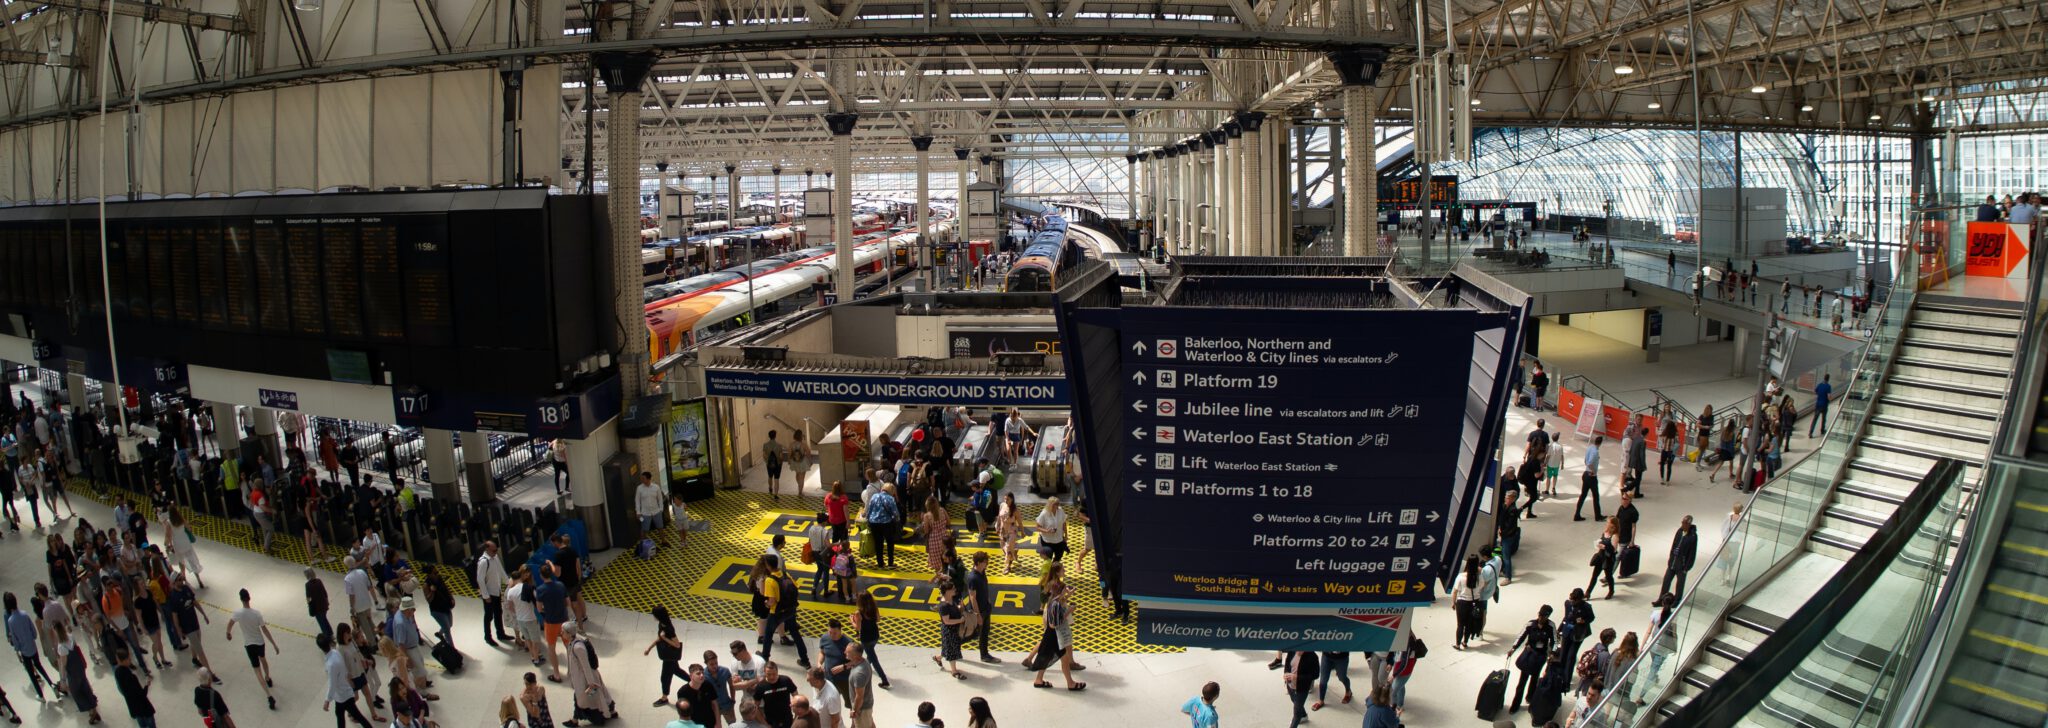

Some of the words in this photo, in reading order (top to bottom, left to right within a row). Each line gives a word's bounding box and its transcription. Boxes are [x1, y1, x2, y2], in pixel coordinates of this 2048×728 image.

[825, 296, 835, 305] 17
[1185, 337, 1243, 350] Bakerloo,
[1247, 338, 1304, 349] Northern
[1308, 339, 1331, 349] and
[1185, 350, 1242, 362] Waterloo
[1246, 352, 1256, 362] &
[1260, 352, 1286, 365] City
[1289, 352, 1318, 363] lines
[1323, 355, 1336, 363] via
[1338, 355, 1382, 363] escalators
[154, 367, 165, 381] 16
[165, 366, 177, 381] 16
[1184, 374, 1252, 387] Platform
[1258, 375, 1277, 388] 19
[783, 381, 861, 395] WATERLOO
[866, 384, 984, 397] UNDERGROUND
[989, 385, 1055, 399] STATION
[400, 397, 415, 413] 17
[418, 393, 428, 412] 17
[1184, 402, 1239, 416] Jubilee
[1245, 403, 1272, 416] line
[1280, 409, 1294, 417] via
[1297, 409, 1347, 417] escalators
[1350, 409, 1368, 417] and
[1370, 409, 1384, 417] lift
[539, 406, 558, 423] 18
[560, 403, 570, 421] 18
[1183, 430, 1254, 444] Waterloo
[1259, 432, 1292, 445] East
[1296, 433, 1352, 445] Station
[1182, 456, 1207, 469] Lift
[1215, 461, 1259, 470] Waterloo
[1262, 462, 1282, 471] East
[1285, 463, 1320, 471] Station
[1182, 482, 1254, 496] Platforms
[1259, 485, 1267, 496] 1
[1273, 486, 1288, 497] to
[1294, 485, 1312, 497] 18
[1268, 514, 1310, 523] Waterloo
[1313, 515, 1320, 523] &
[1323, 515, 1342, 524] City
[1345, 515, 1362, 523] line
[1368, 512, 1392, 523] Lift
[1253, 535, 1323, 547] Platforms
[1328, 536, 1346, 547] 20
[1351, 537, 1366, 547] to
[1370, 536, 1388, 547] 24
[1296, 559, 1325, 570] Left
[1329, 559, 1385, 572] luggage
[1174, 575, 1215, 584] Waterloo
[1217, 577, 1248, 586] Bridge
[867, 583, 1026, 608] CLER
[1195, 585, 1223, 593] South
[1224, 586, 1247, 594] Bank
[1325, 583, 1353, 595] Way
[1357, 584, 1381, 593] out
[1151, 622, 1210, 636] Welcome
[1216, 625, 1230, 638] to
[1234, 627, 1299, 640] Waterloo
[1302, 628, 1353, 641] Station
